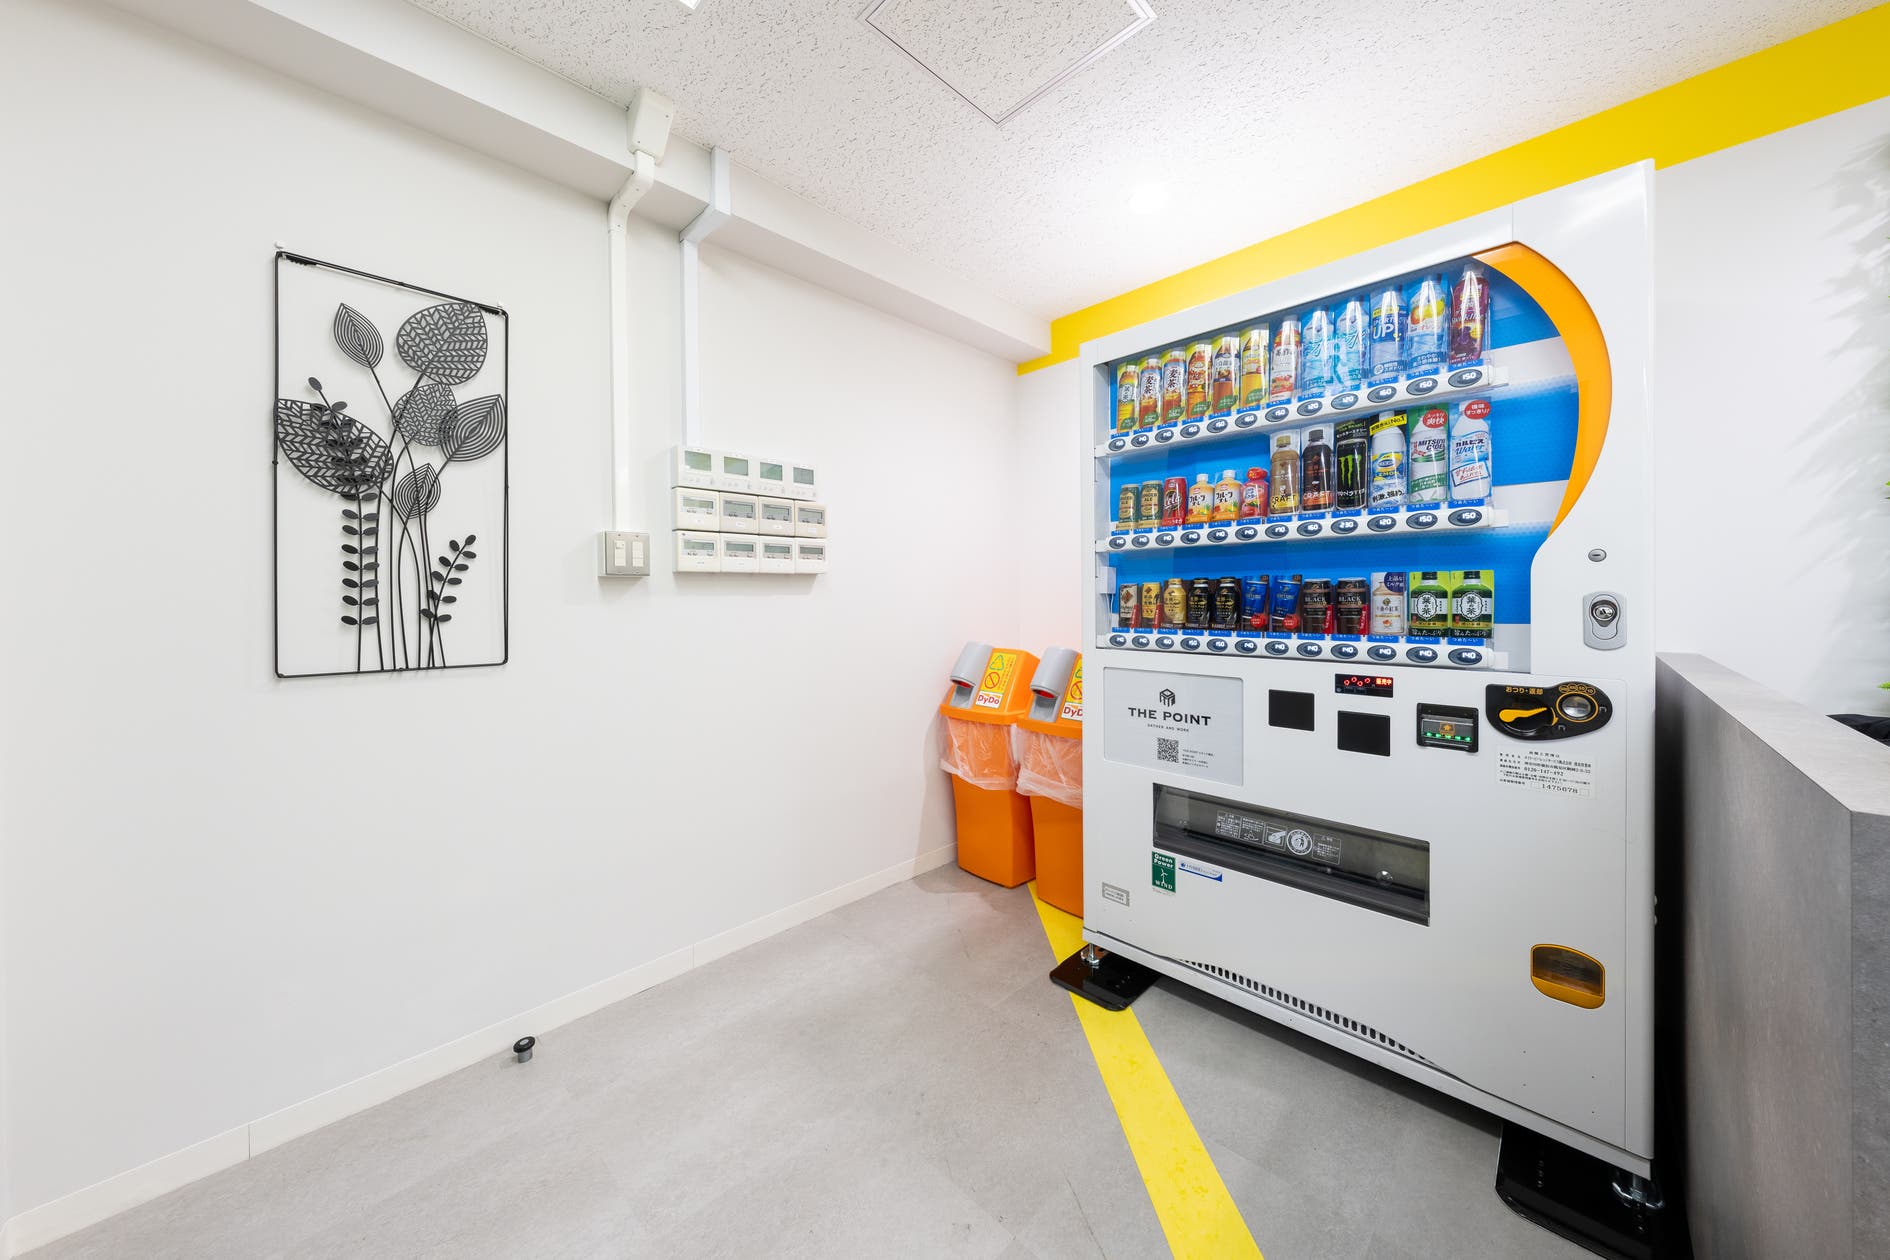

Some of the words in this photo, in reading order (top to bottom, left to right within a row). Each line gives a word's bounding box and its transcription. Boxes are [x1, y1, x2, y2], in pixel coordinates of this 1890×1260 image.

[1462, 372, 1476, 380] 150
[1190, 495, 1206, 503] フルーツ
[1216, 492, 1233, 501] フルーツ
[977, 694, 1000, 705] DyDo
[1128, 707, 1157, 719] THE
[1163, 711, 1211, 726] POINT
[1154, 853, 1173, 863] Green
[1153, 859, 1174, 869] Power
[1154, 879, 1173, 890] WIND
